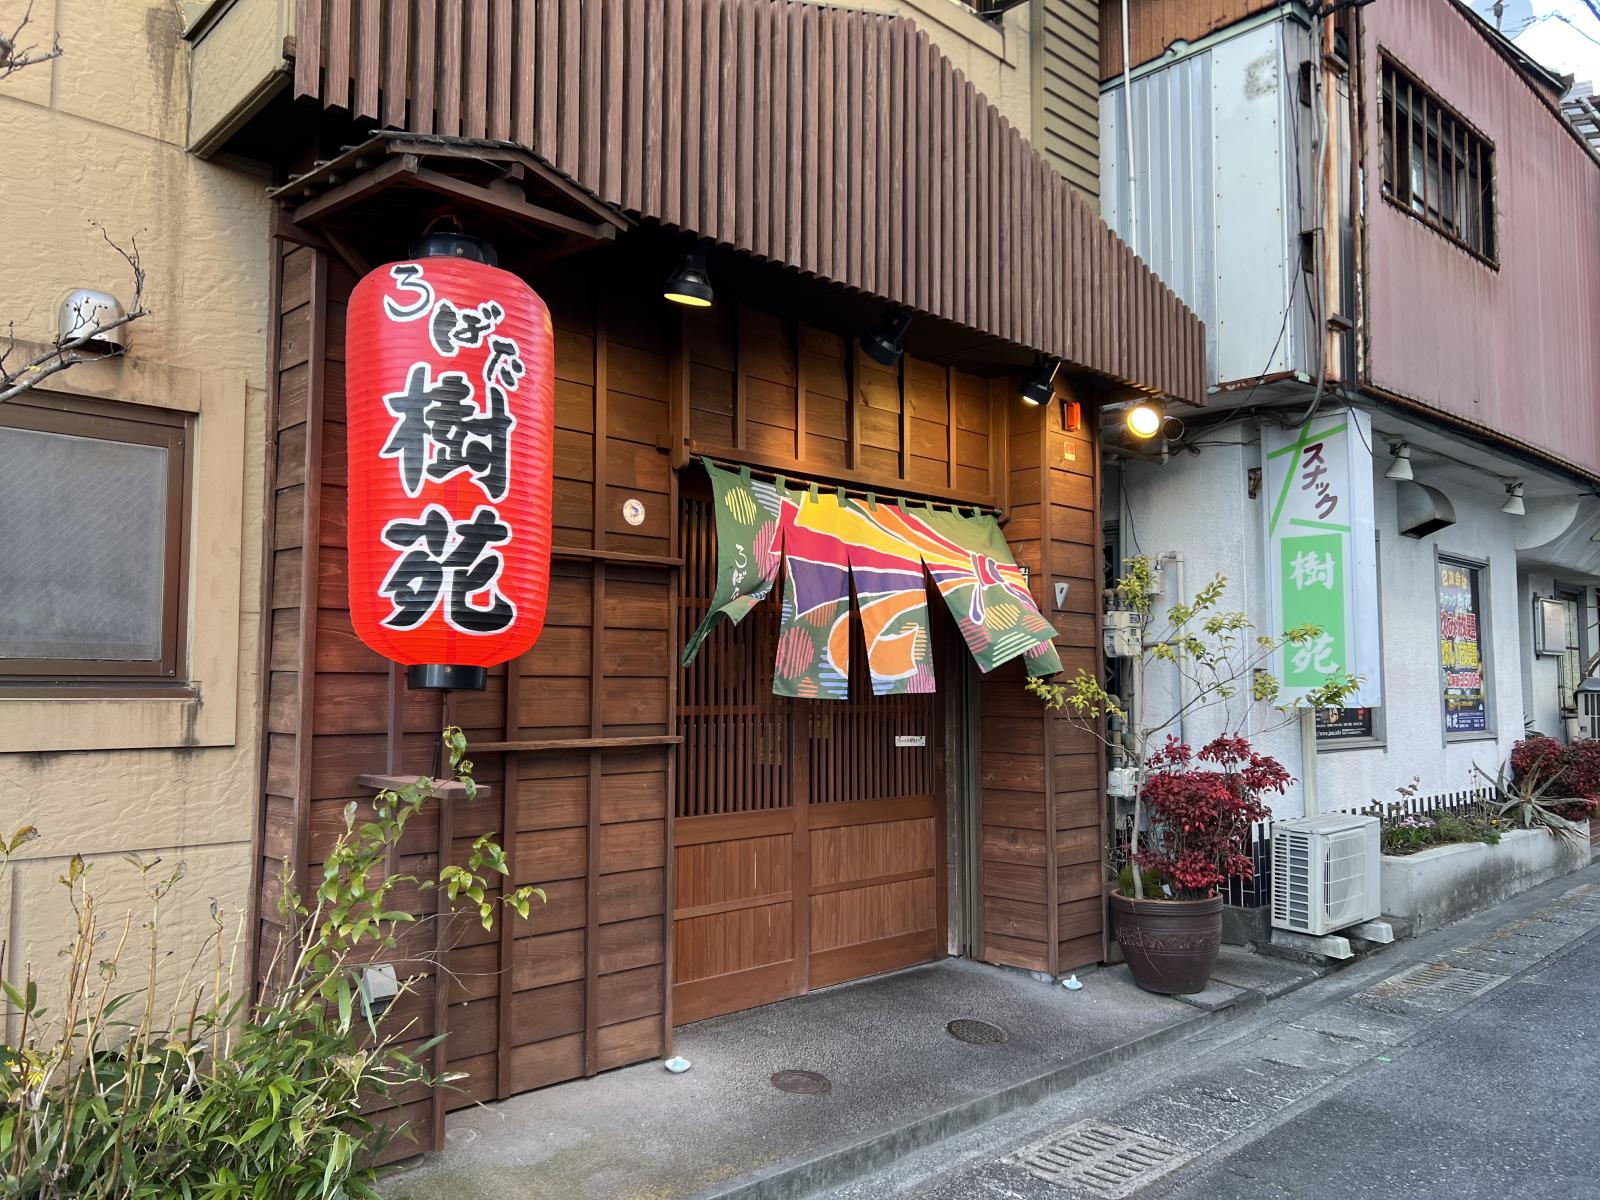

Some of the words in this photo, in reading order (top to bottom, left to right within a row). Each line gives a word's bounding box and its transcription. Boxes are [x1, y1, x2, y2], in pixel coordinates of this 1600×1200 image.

[384, 264, 525, 391] ろばた
[379, 361, 517, 634] 樹苑
[1302, 442, 1338, 520] スナック
[1289, 550, 1340, 674] 樹苑
